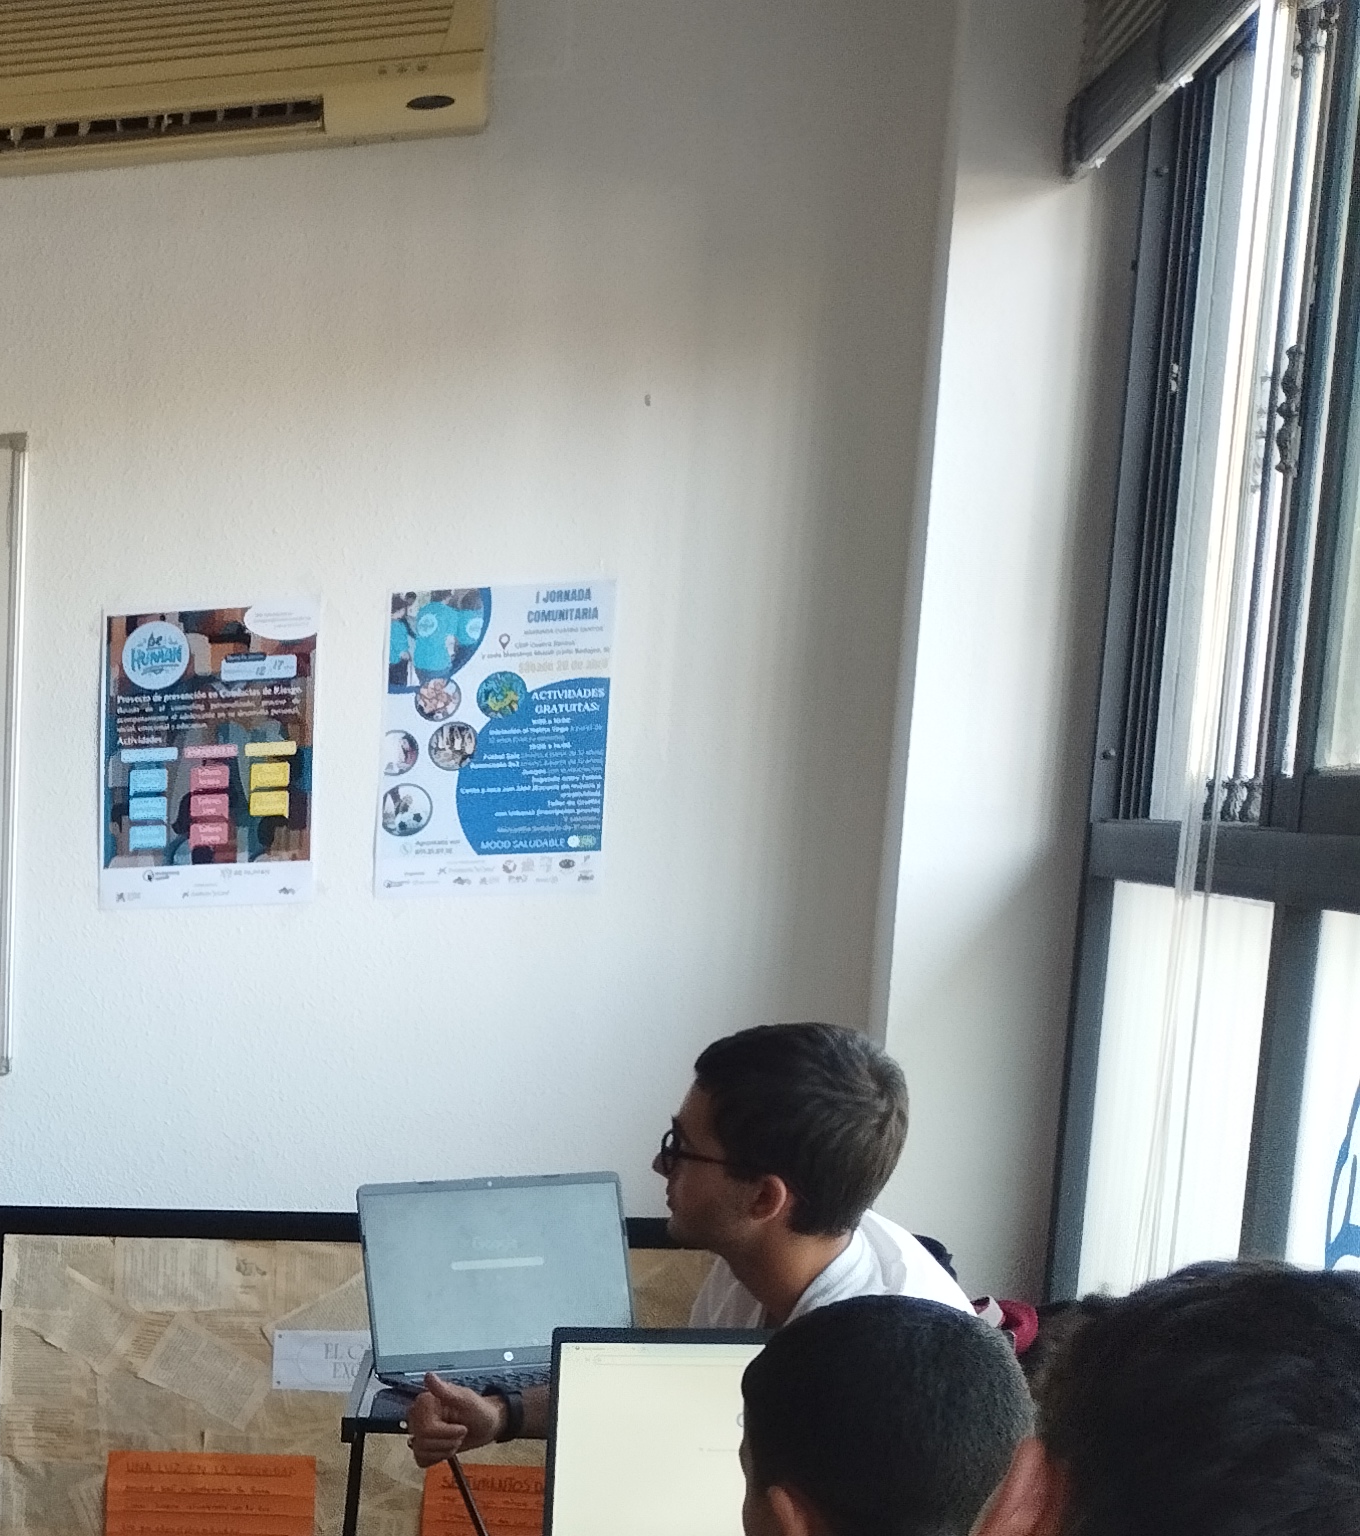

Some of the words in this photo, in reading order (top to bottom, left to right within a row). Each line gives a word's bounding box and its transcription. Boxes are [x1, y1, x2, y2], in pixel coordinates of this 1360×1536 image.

[542, 587, 591, 604] JORNADA
[527, 606, 599, 624] COMUNITARIA
[531, 687, 606, 701] ACTIVIDADES
[513, 837, 566, 849] SALUDABLE
